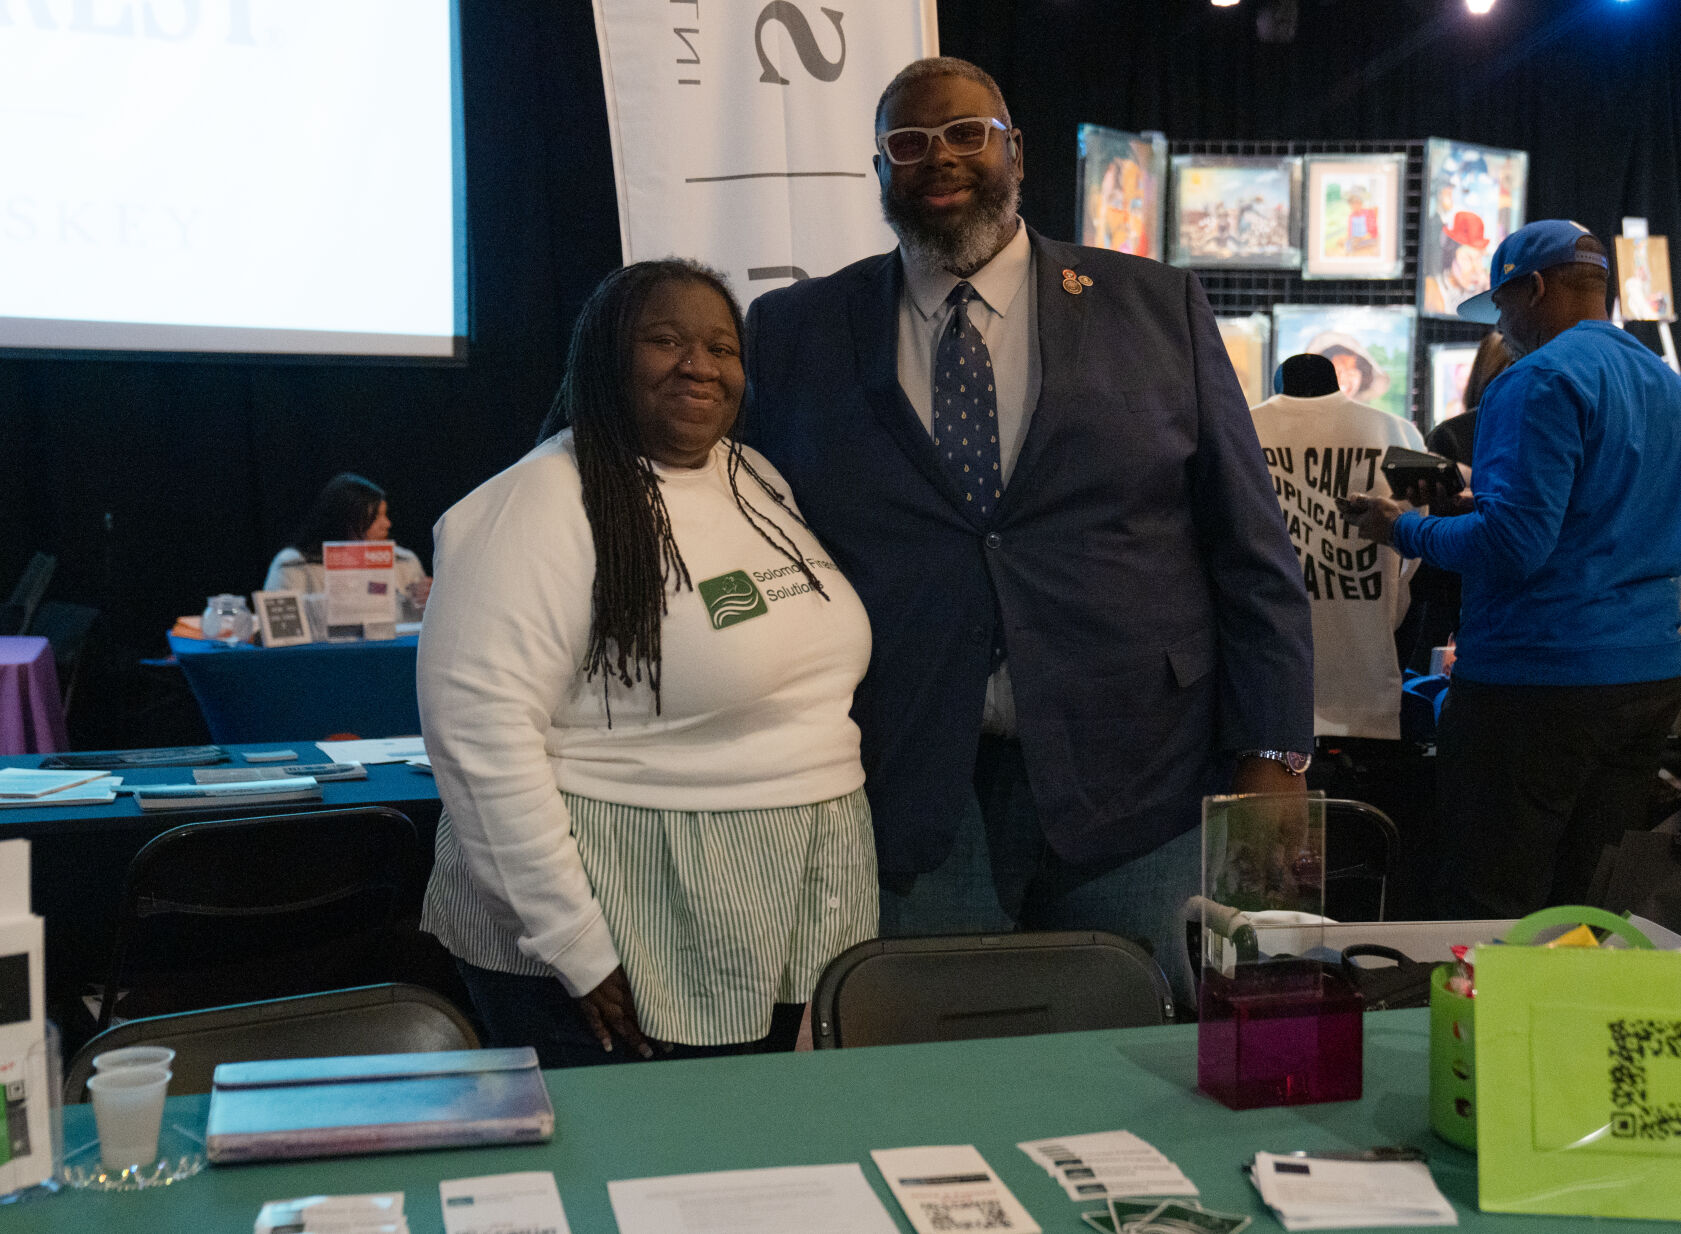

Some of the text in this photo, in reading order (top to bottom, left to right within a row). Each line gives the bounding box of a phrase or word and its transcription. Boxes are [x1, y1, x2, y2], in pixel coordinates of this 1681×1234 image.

[1262, 447, 1382, 499] OU CAN'T
[1271, 475, 1351, 539] UPLICAT
[753, 563, 803, 582] Solomo
[1297, 547, 1382, 600] ATED
[1321, 538, 1378, 573] GOD
